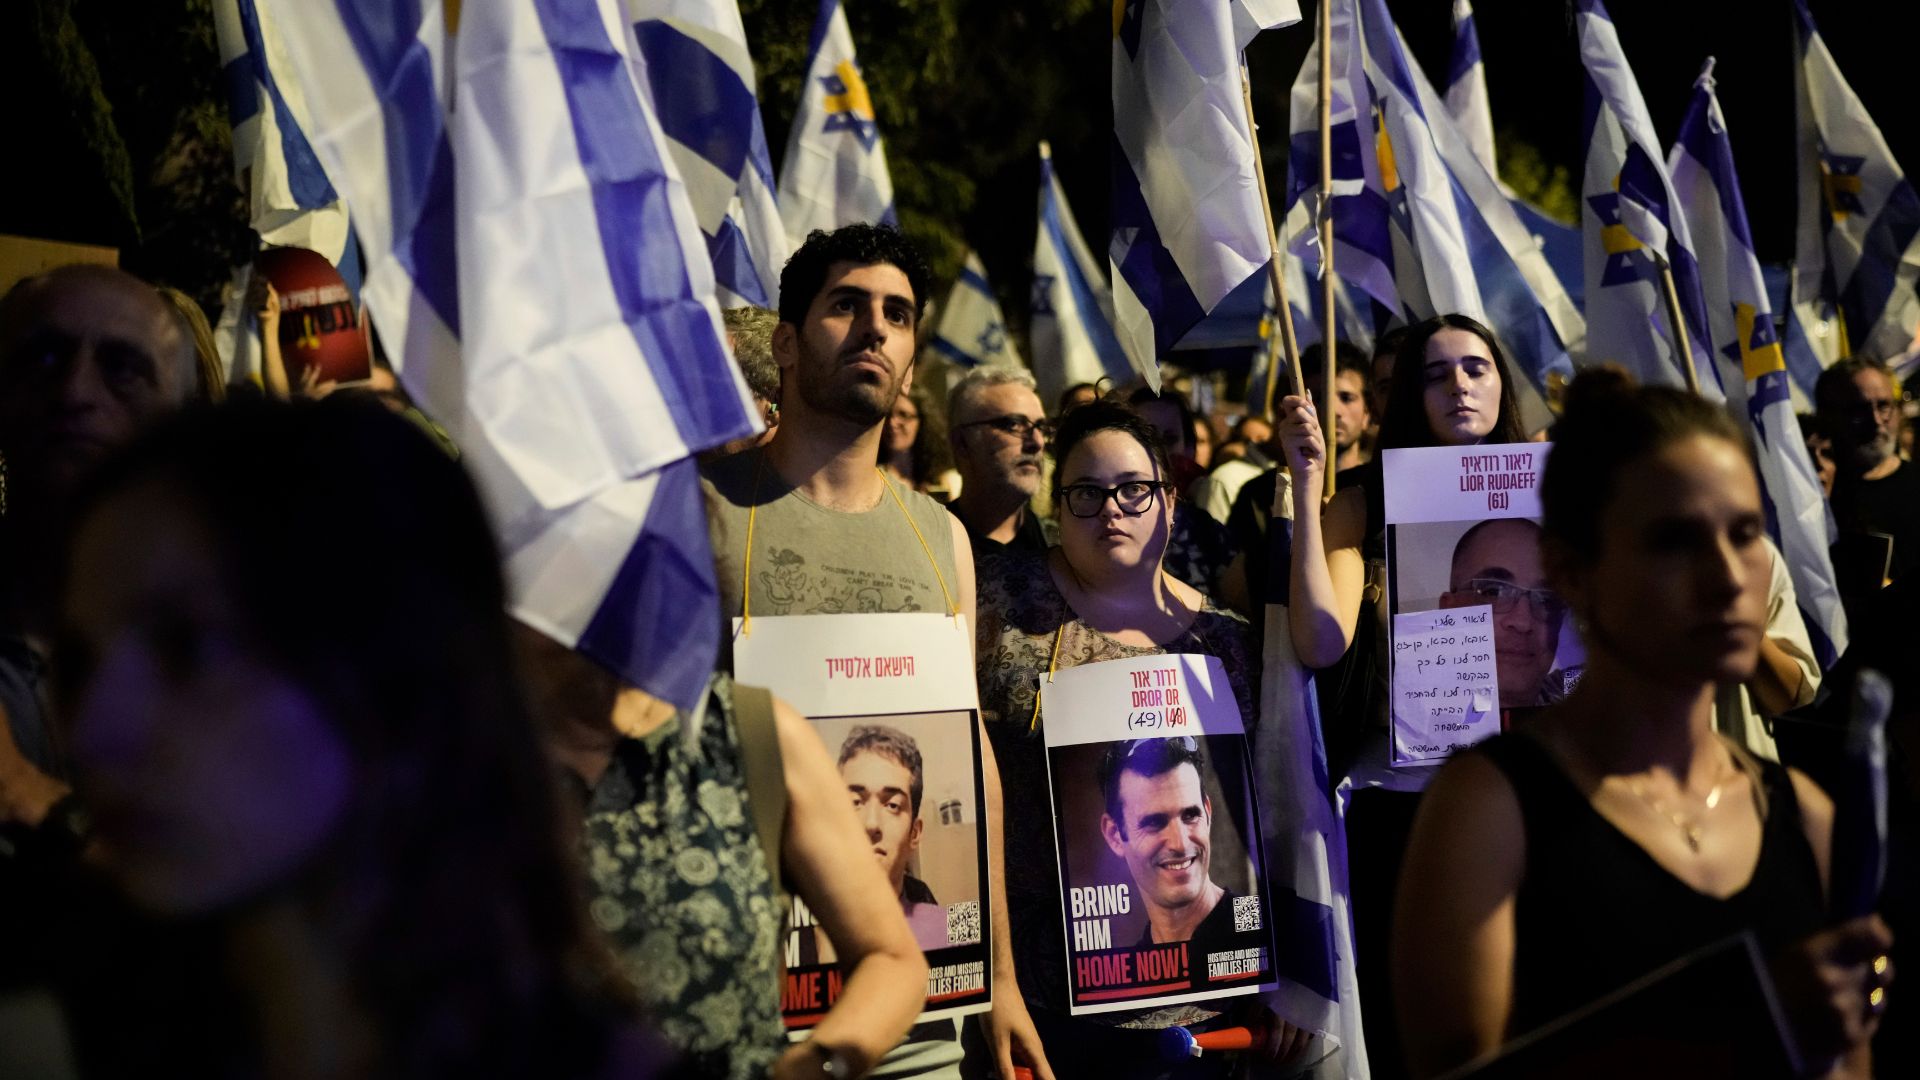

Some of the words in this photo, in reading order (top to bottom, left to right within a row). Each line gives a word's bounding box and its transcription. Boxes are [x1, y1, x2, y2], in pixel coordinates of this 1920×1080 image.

[1461, 455, 1500, 474] רודאיף
[1502, 453, 1533, 470] ליאור
[1460, 475, 1485, 492] LIOR
[1488, 472, 1536, 490] RUDAEFF
[1488, 491, 1509, 511] (61)
[825, 657, 871, 679] אלסייד
[875, 656, 915, 678] הישאם
[1130, 671, 1151, 688] אור
[1153, 669, 1177, 687] דרור
[1132, 690, 1163, 708] DROR
[1165, 689, 1180, 706] OR
[1128, 711, 1163, 731] (49)
[1070, 884, 1130, 919] BRING
[1073, 919, 1112, 952] HIM
[1076, 952, 1132, 988] HOME
[1136, 943, 1190, 982] NOW!
[1207, 950, 1234, 964] HOSTAGES
[1235, 950, 1245, 960] AND
[928, 966, 943, 980] AGES
[944, 965, 956, 978] AND
[957, 960, 984, 976] MISSING
[1208, 960, 1242, 978] FAMILIES
[779, 971, 822, 1011] ME
[928, 977, 952, 996] ILIES
[953, 973, 984, 993] FORUM
